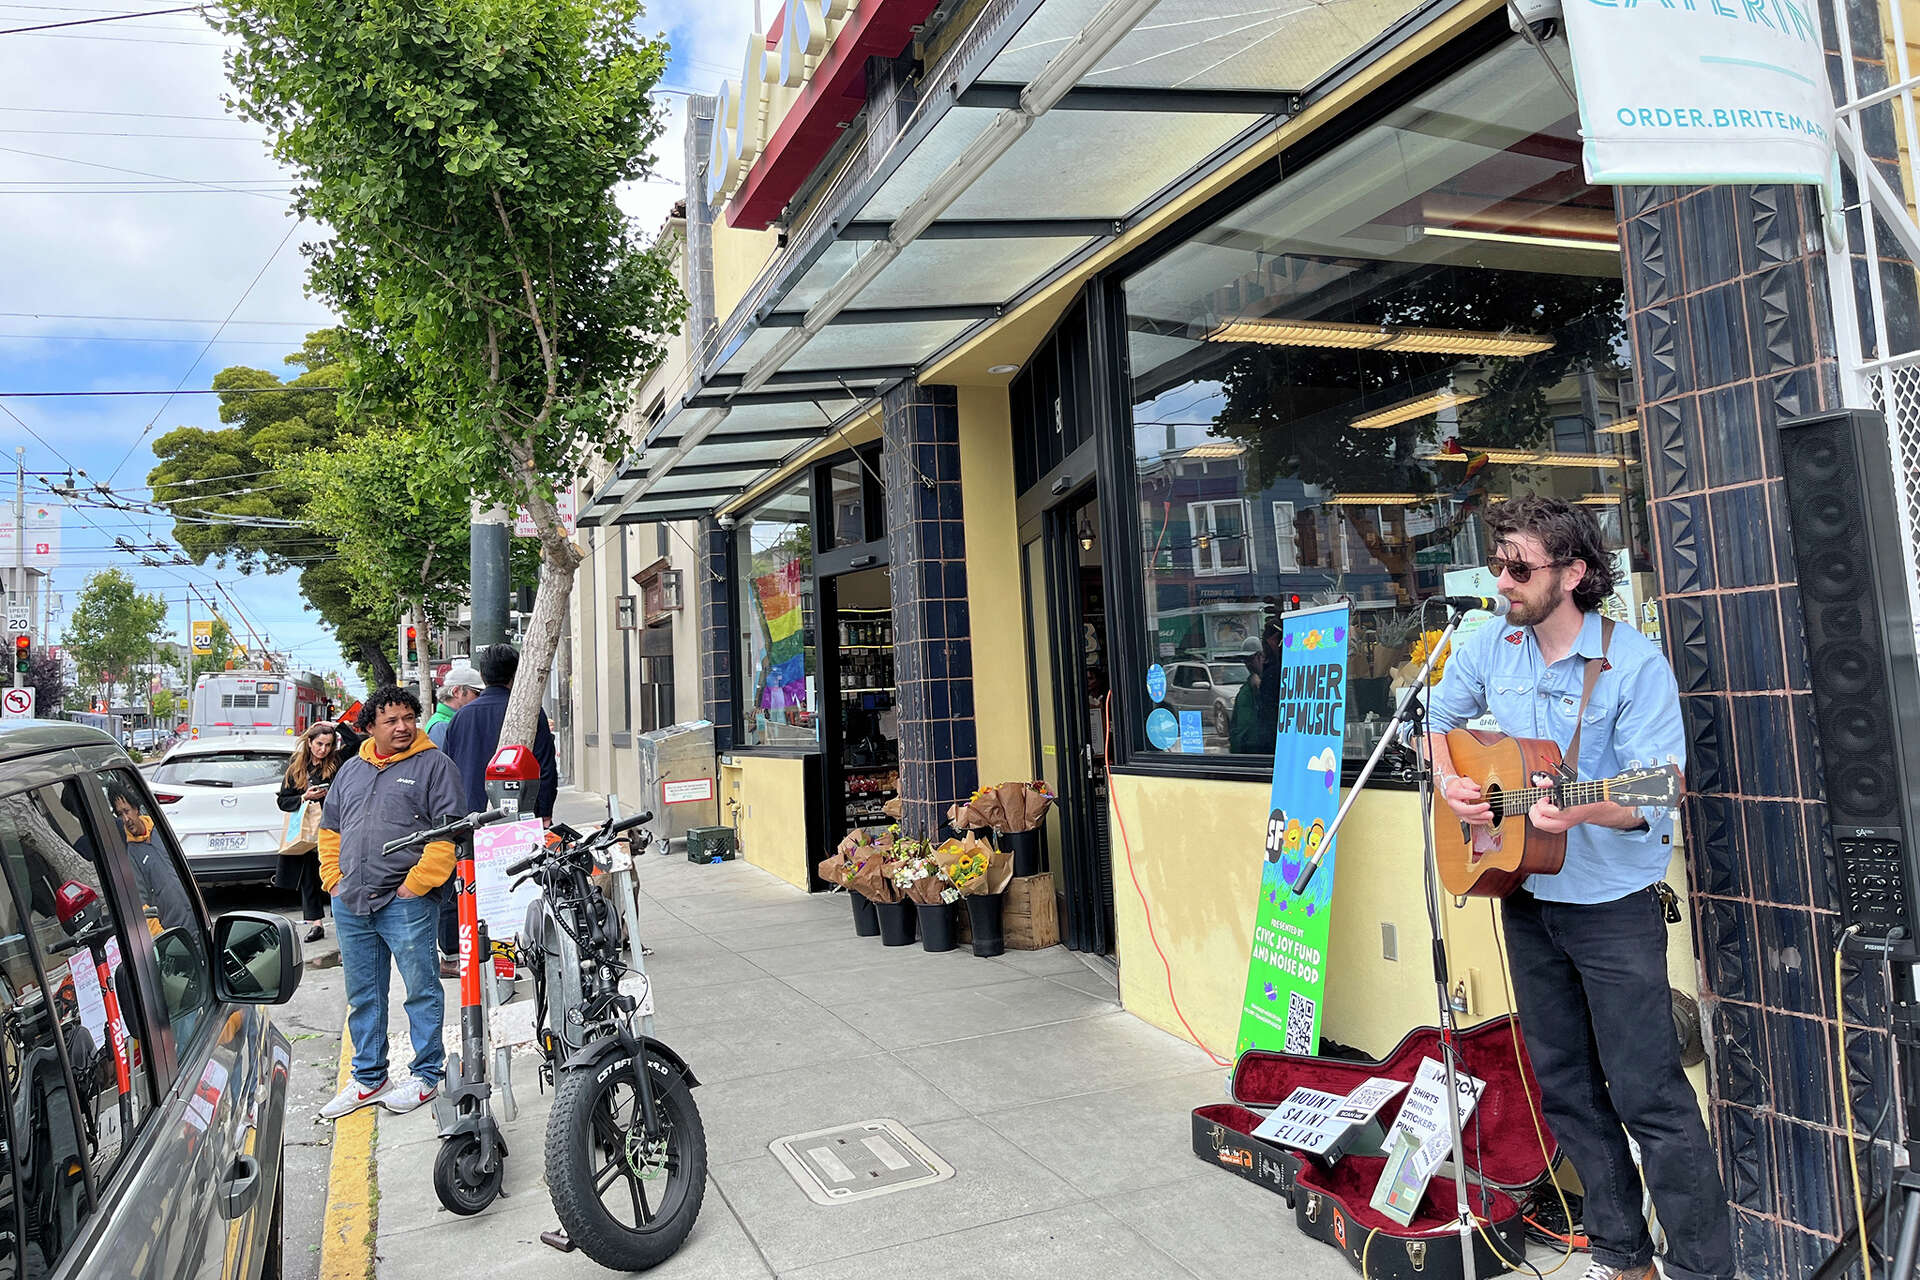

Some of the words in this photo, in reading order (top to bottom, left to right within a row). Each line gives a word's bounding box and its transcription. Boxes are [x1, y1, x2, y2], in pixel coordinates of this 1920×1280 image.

[9, 619, 28, 630] 20
[194, 634, 211, 647] 20
[1280, 663, 1342, 700] SUMMER
[1278, 702, 1295, 733] OF
[1295, 702, 1342, 736] MUSIC
[1265, 818, 1285, 851] SF
[476, 850, 490, 859] NO
[1271, 918, 1297, 935] PRESENTED
[1297, 927, 1305, 937] BY
[459, 923, 472, 977] SPIN
[1256, 926, 1275, 947] CIVIC
[1276, 935, 1293, 955] JOY
[1294, 941, 1320, 965] FUND
[1253, 944, 1269, 962] AND
[1270, 950, 1297, 976] NOISE
[1297, 962, 1319, 984] POP
[597, 1064, 613, 1084] CST
[1287, 1091, 1337, 1111] MOUNT
[1412, 1086, 1440, 1105] SHIRTS
[1407, 1097, 1435, 1116] PRINTS
[1282, 1108, 1330, 1129] SAINT
[1401, 1109, 1438, 1132] STICKERS
[1274, 1125, 1324, 1147] ELIAS
